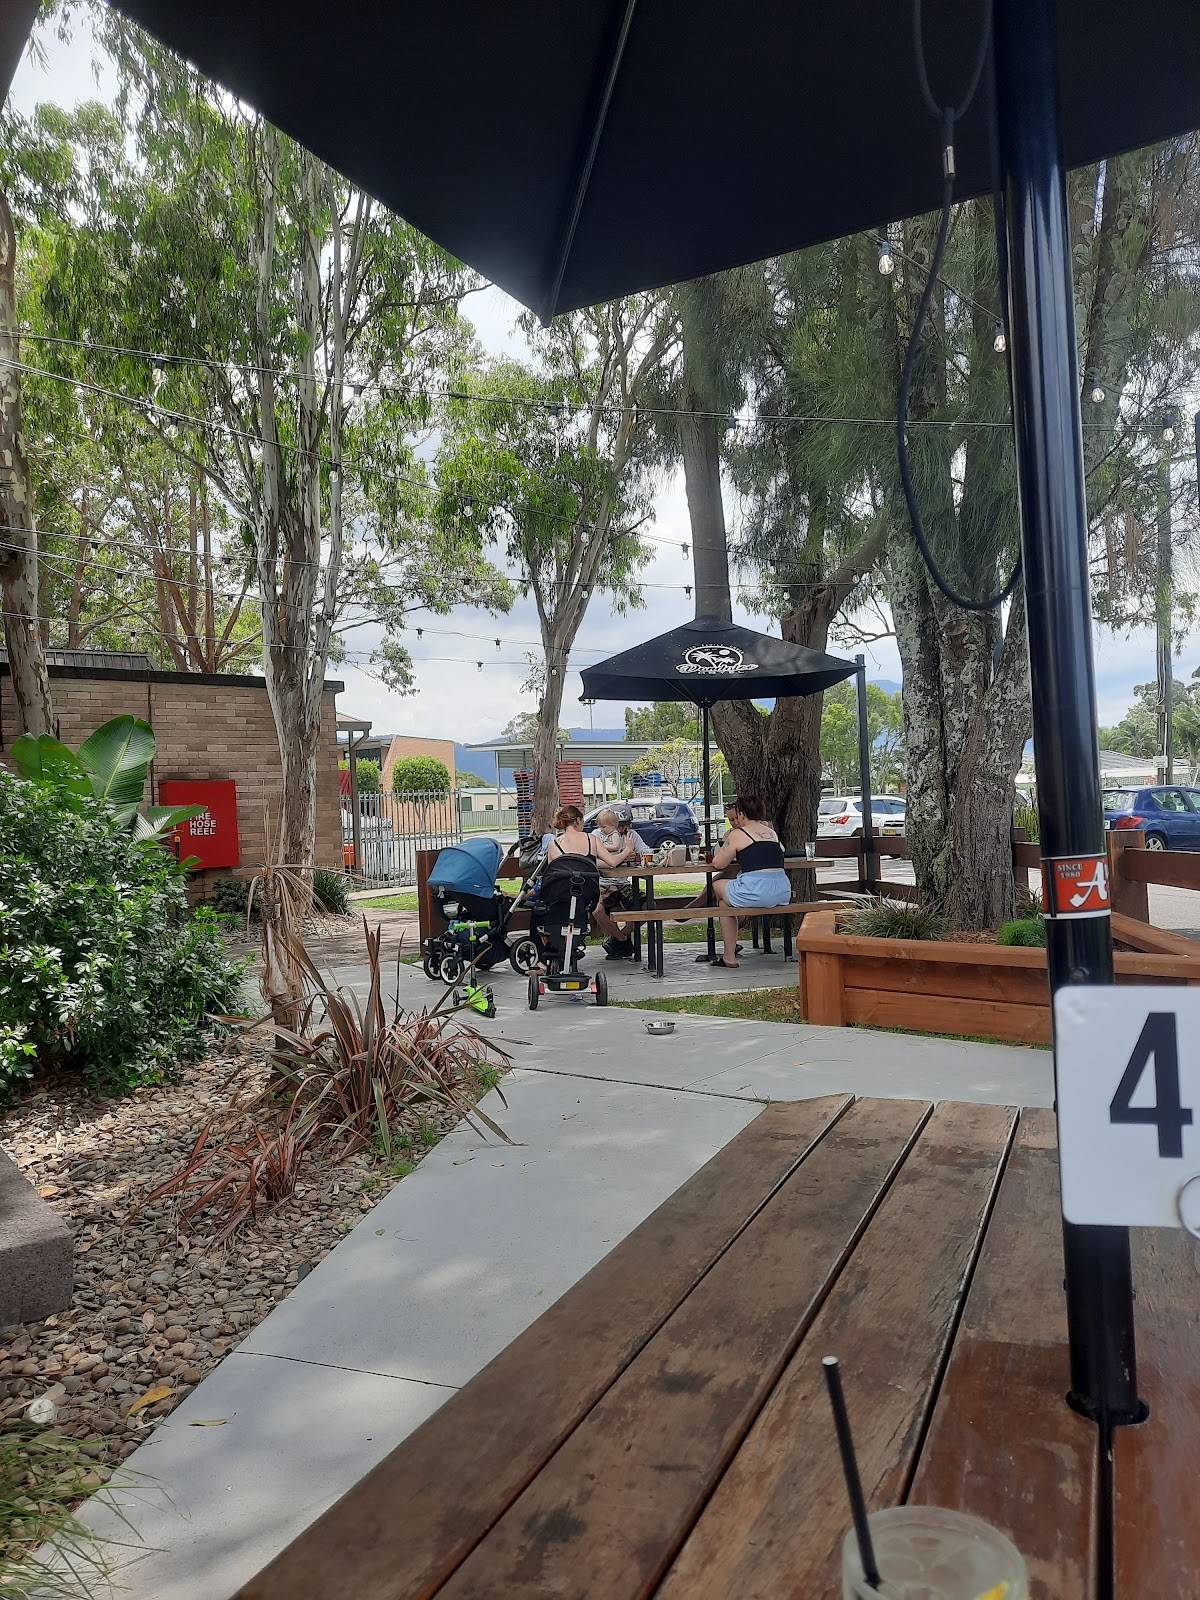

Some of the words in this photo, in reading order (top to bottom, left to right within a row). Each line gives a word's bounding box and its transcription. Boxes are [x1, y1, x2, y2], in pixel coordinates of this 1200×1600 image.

[190, 812, 212, 820] IRE
[190, 820, 217, 828] HOSE
[190, 828, 216, 836] REEL
[1057, 863, 1083, 872] SINCE
[1110, 1012, 1193, 1158] 4
